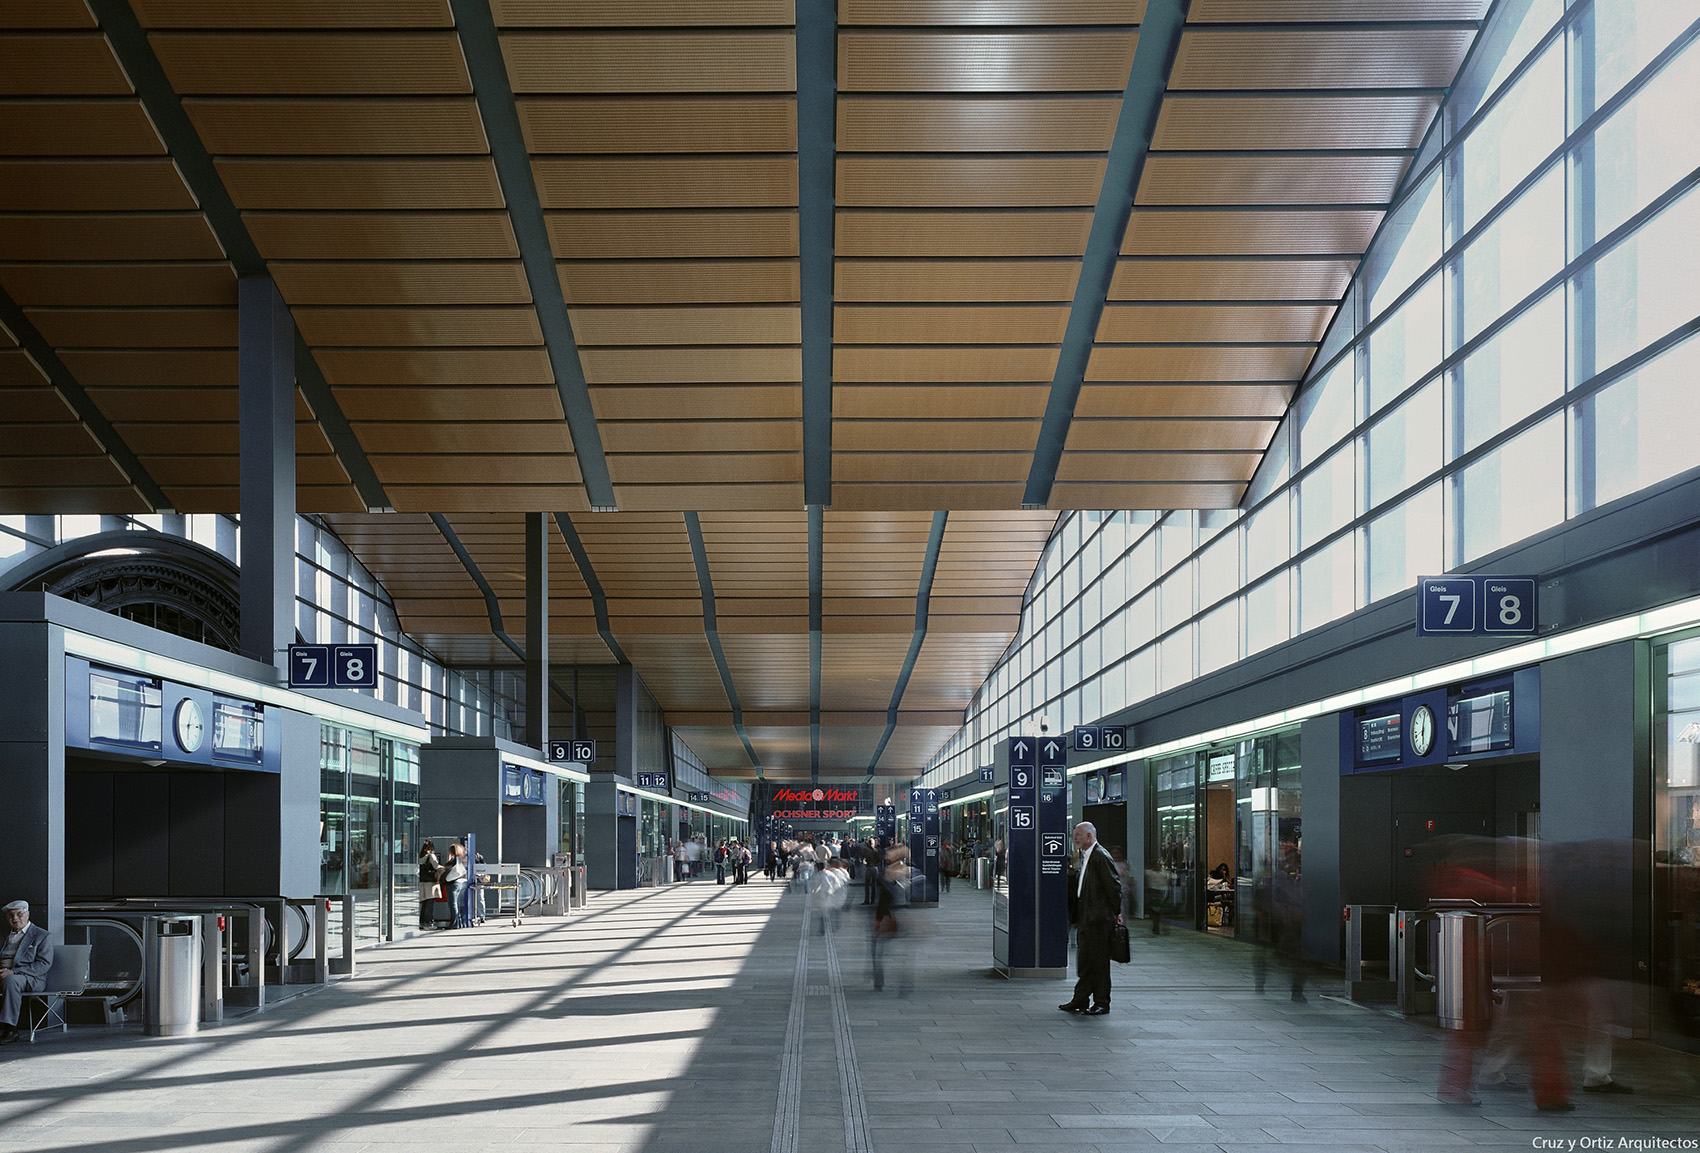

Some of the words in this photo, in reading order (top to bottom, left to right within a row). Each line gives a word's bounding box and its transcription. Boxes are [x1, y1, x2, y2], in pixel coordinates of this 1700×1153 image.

[1440, 595, 1460, 624] 7
[1499, 595, 1521, 625] 8
[302, 658, 317, 680] 7
[346, 658, 364, 681] 8
[249, 725, 254, 737] 8
[1363, 729, 1368, 740] 8
[1082, 733, 1093, 747] 9
[1104, 733, 1122, 747] 10
[556, 746, 565, 759] 9
[575, 746, 591, 759] 10
[640, 777, 649, 786] 11
[655, 777, 665, 786] 12
[983, 771, 993, 780] 11
[1017, 772, 1027, 786] 9
[773, 788, 813, 802] Media
[820, 788, 858, 802] Markt
[1043, 794, 1051, 802] 16
[773, 810, 821, 819] OCHSNER
[822, 810, 857, 819] SPORT
[913, 805, 921, 813] 11
[1014, 813, 1030, 827] 15
[1428, 820, 1433, 829] F
[913, 825, 922, 833] 15
[1049, 843, 1058, 854] P
